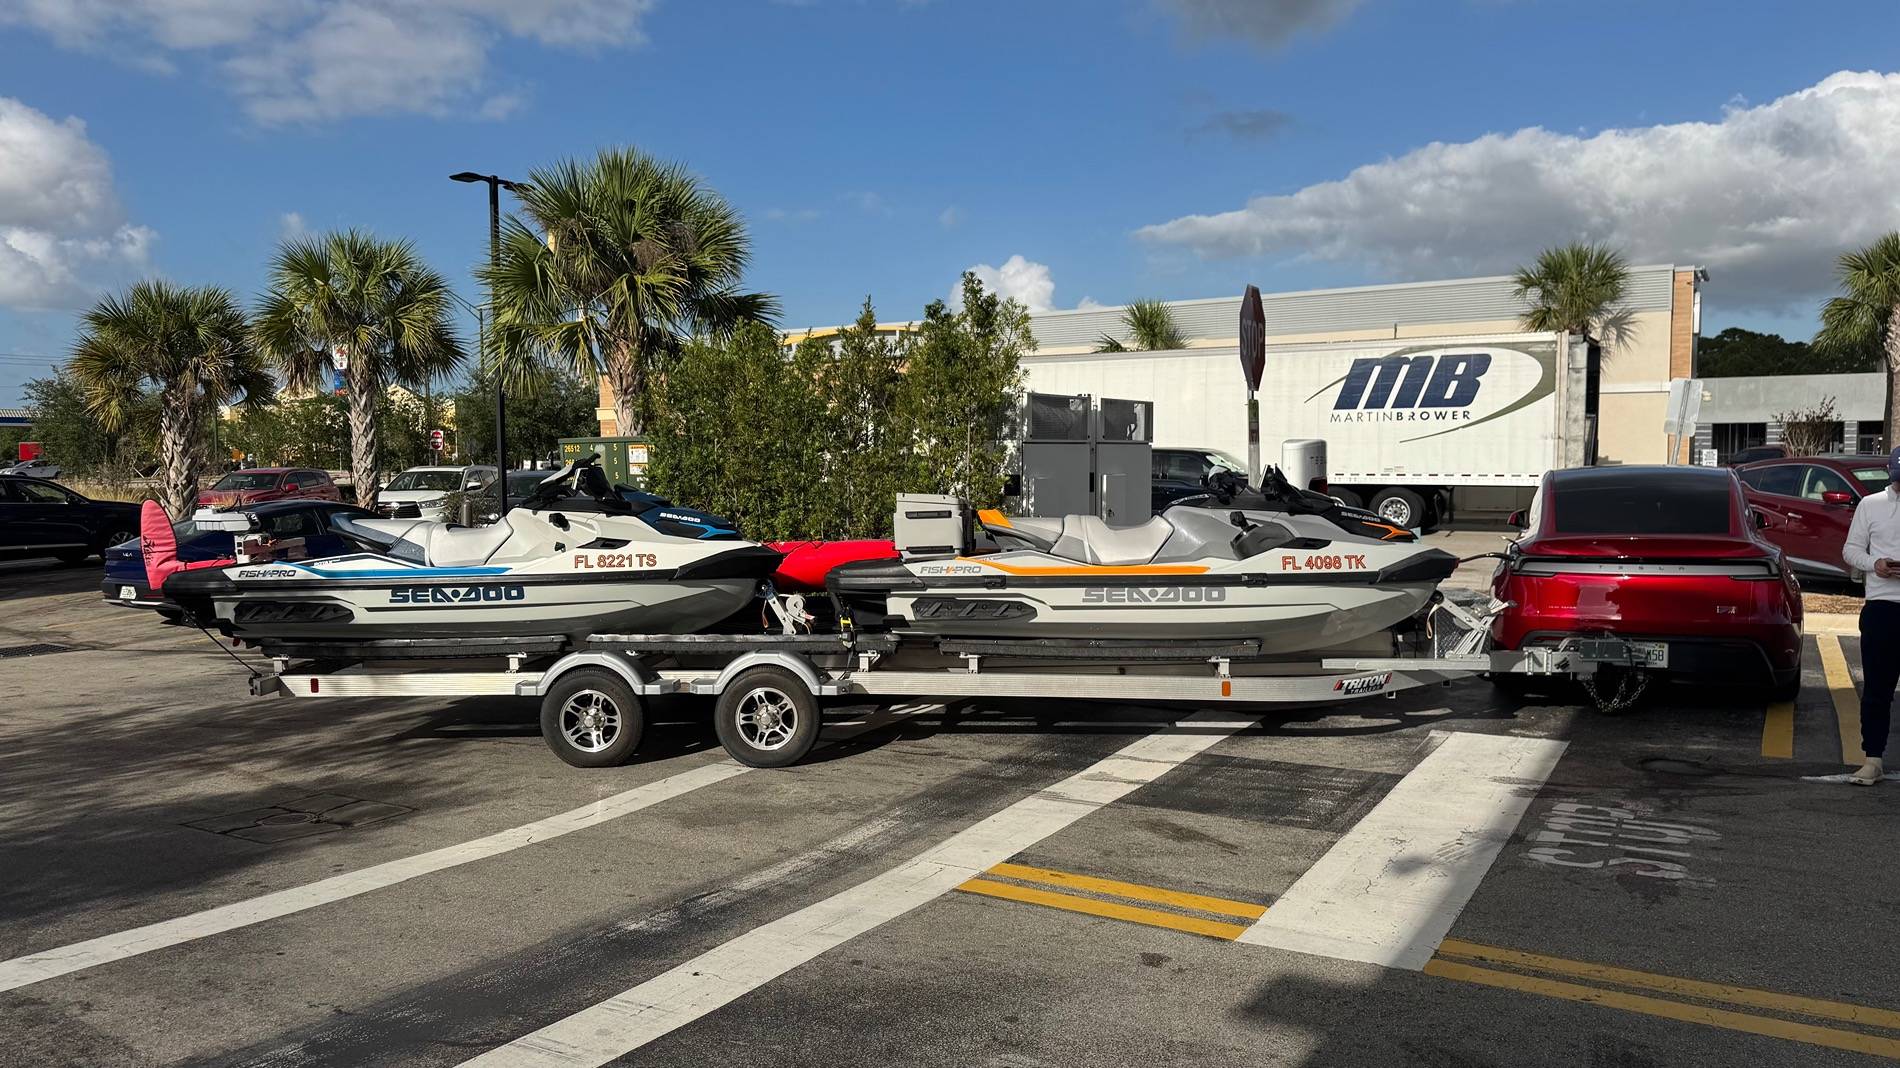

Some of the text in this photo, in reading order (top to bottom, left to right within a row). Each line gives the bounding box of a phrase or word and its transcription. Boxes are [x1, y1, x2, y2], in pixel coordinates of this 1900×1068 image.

[1241, 318, 1264, 358] STOP
[1333, 353, 1492, 410] MB
[574, 553, 657, 569] FL 8221 TS
[1281, 554, 1367, 570] FL 4098 TK
[1342, 673, 1389, 690] TRITON
